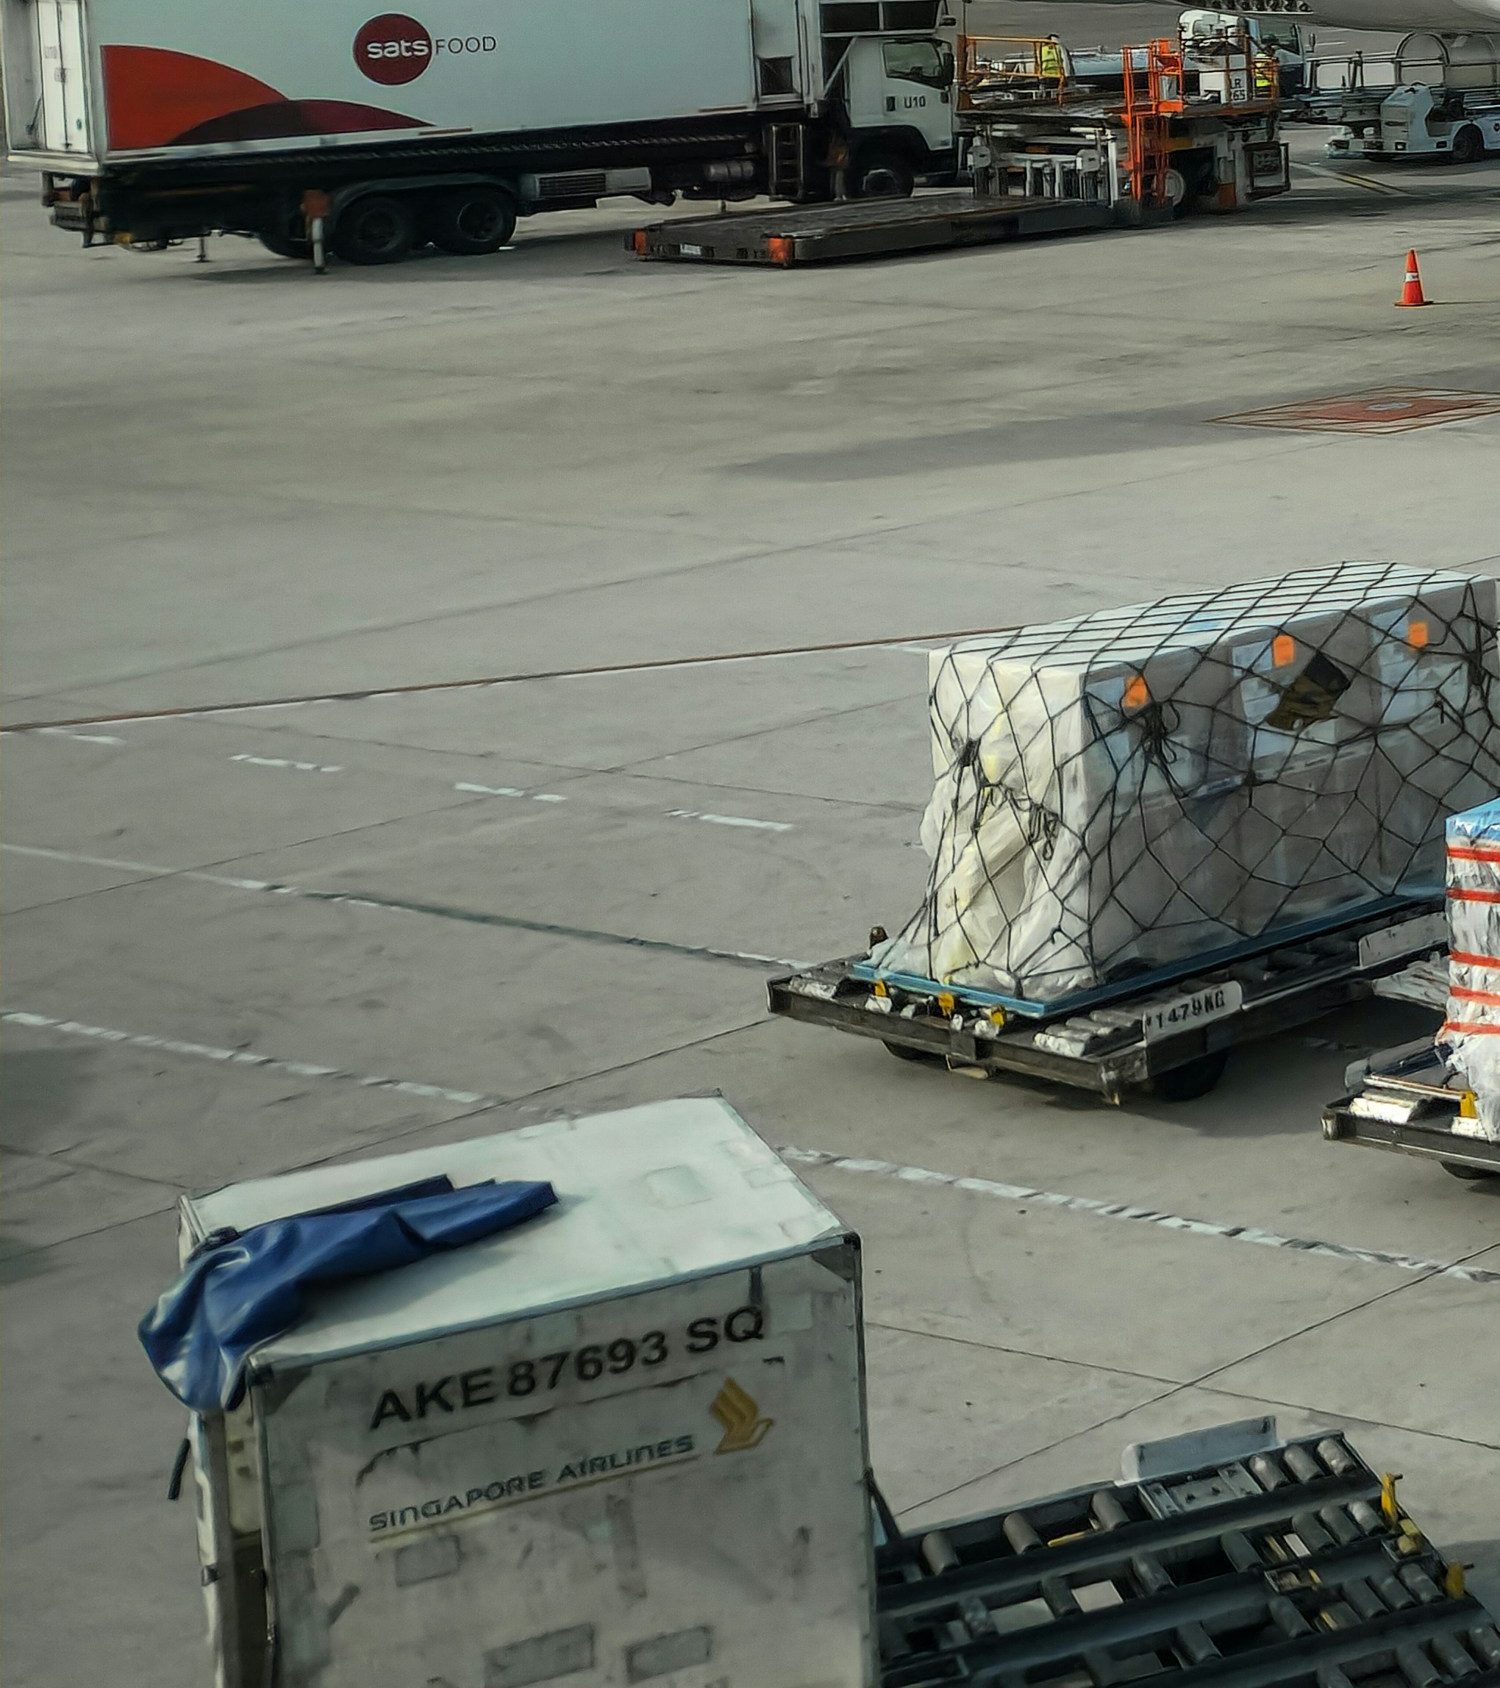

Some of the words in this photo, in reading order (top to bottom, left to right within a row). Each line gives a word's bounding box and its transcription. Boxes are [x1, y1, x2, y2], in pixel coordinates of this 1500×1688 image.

[367, 39, 430, 60] sats
[435, 36, 497, 55] FOOD
[904, 95, 926, 109] U10
[370, 1366, 498, 1431] AKE
[507, 1330, 670, 1399] 87693
[685, 1304, 766, 1356] SQ
[370, 1468, 547, 1532] SINGAPORE
[556, 1433, 697, 1485] AIRLINES
